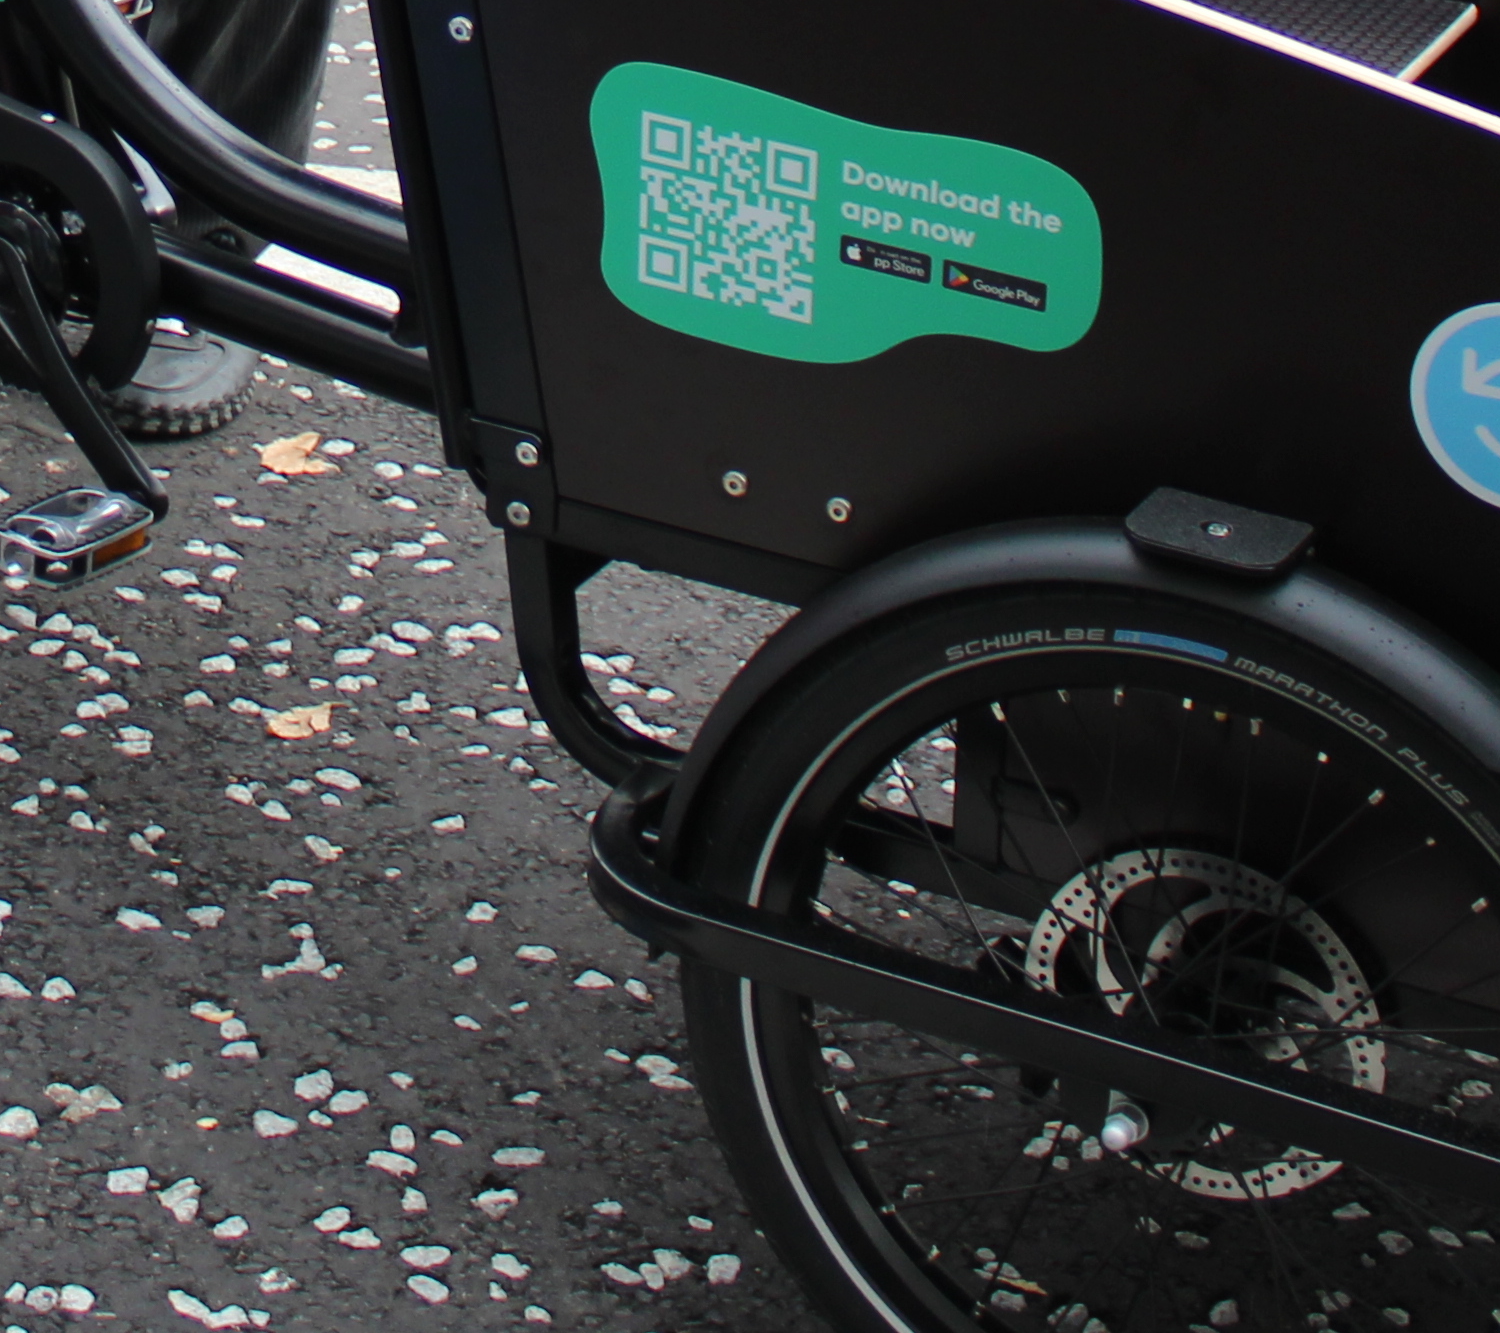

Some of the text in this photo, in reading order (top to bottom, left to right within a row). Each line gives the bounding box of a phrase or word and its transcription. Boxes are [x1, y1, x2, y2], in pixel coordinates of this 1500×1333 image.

[842, 160, 1064, 234] Download the
[841, 201, 977, 249] app now
[892, 259, 926, 278] Store
[972, 278, 1042, 307] Google Play
[945, 627, 1106, 663] SCHWALBE
[1233, 656, 1389, 741] MARATHON
[1396, 745, 1471, 807] PLUS
